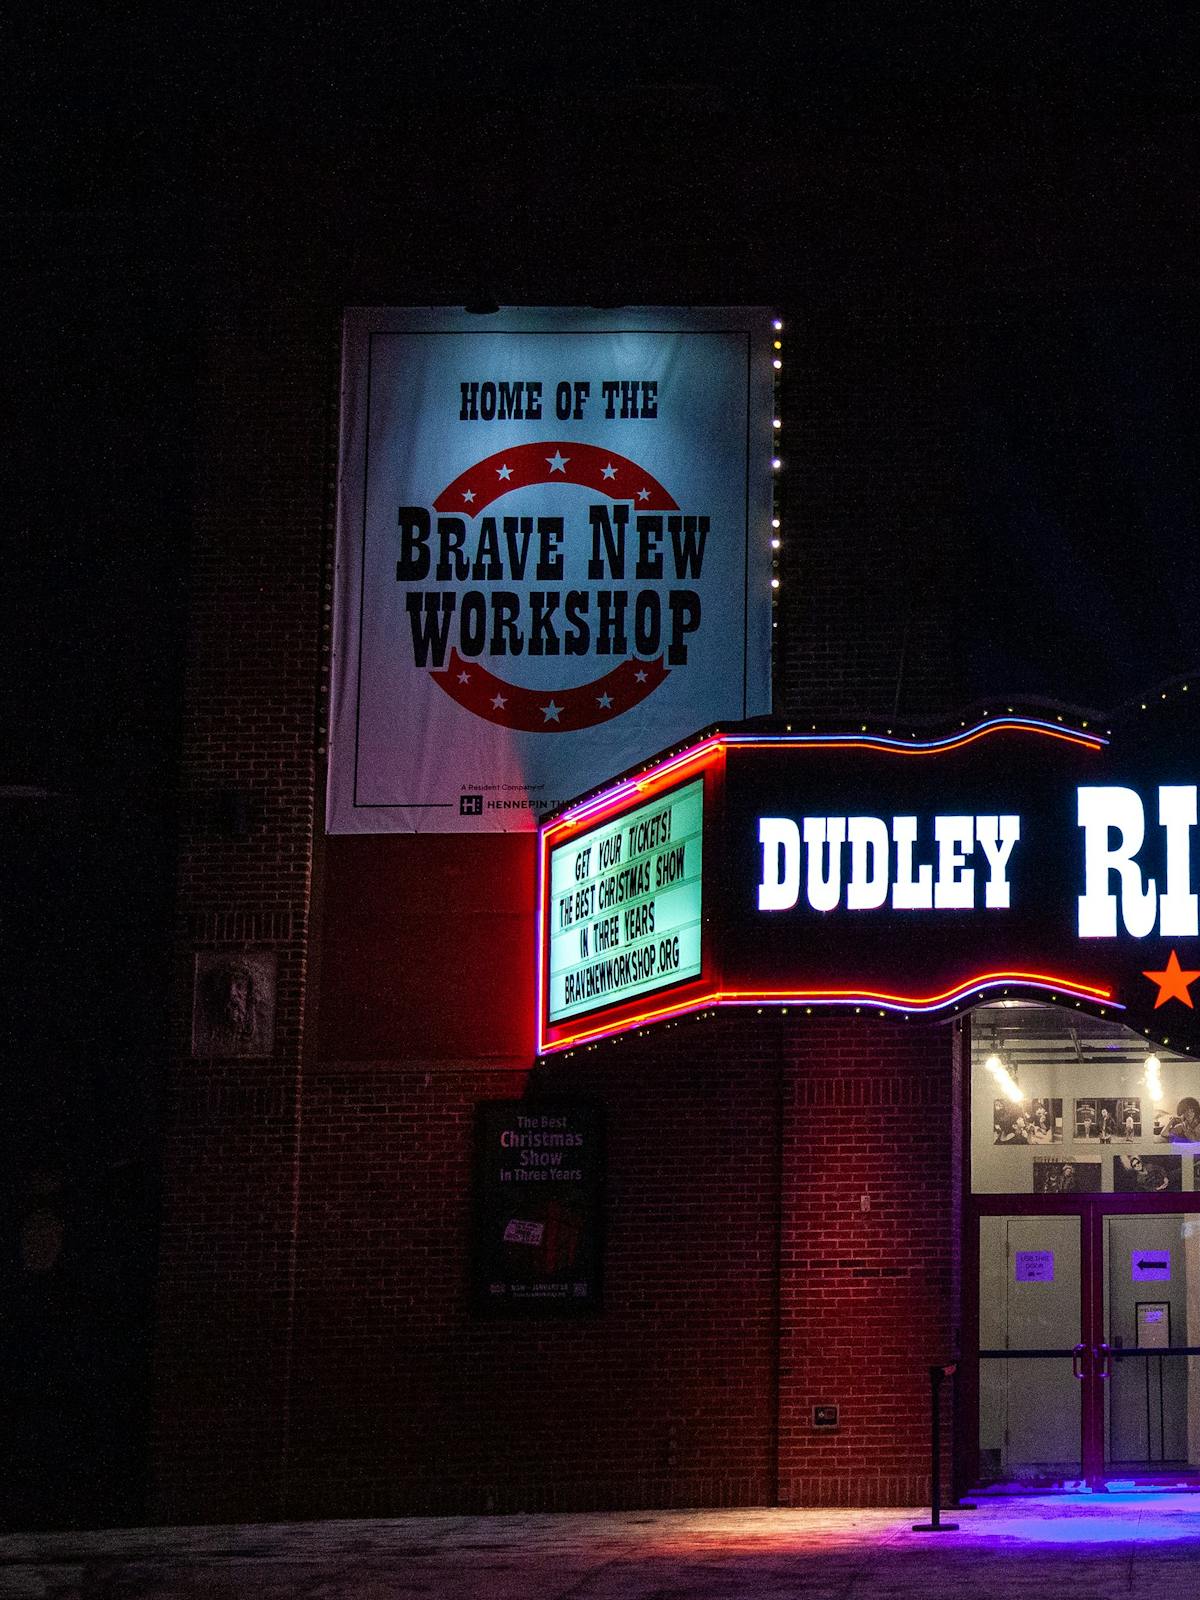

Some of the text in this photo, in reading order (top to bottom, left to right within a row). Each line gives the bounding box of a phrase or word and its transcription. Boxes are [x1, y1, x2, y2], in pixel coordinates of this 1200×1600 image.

[459, 381, 658, 421] HOME OF THE
[396, 504, 710, 581] BRAVE NEW
[406, 589, 701, 667] WORKSHOP
[487, 800, 548, 809] HENNEPIN
[501, 784, 536, 792] Company
[575, 809, 672, 881] GET YOUR TICKETS!
[758, 815, 1020, 911] DUDLEY
[560, 846, 686, 927] THE BEST CHRISTMAS SHOW
[580, 901, 655, 958] IN THREE YEARS
[565, 936, 680, 1005] BRAVENEWWORKSHOP.ORG
[500, 1130, 584, 1148] Christmas
[517, 1116, 568, 1128] The Best
[514, 1168, 548, 1181] Three
[550, 1167, 582, 1181] Years
[520, 1149, 562, 1166] Show
